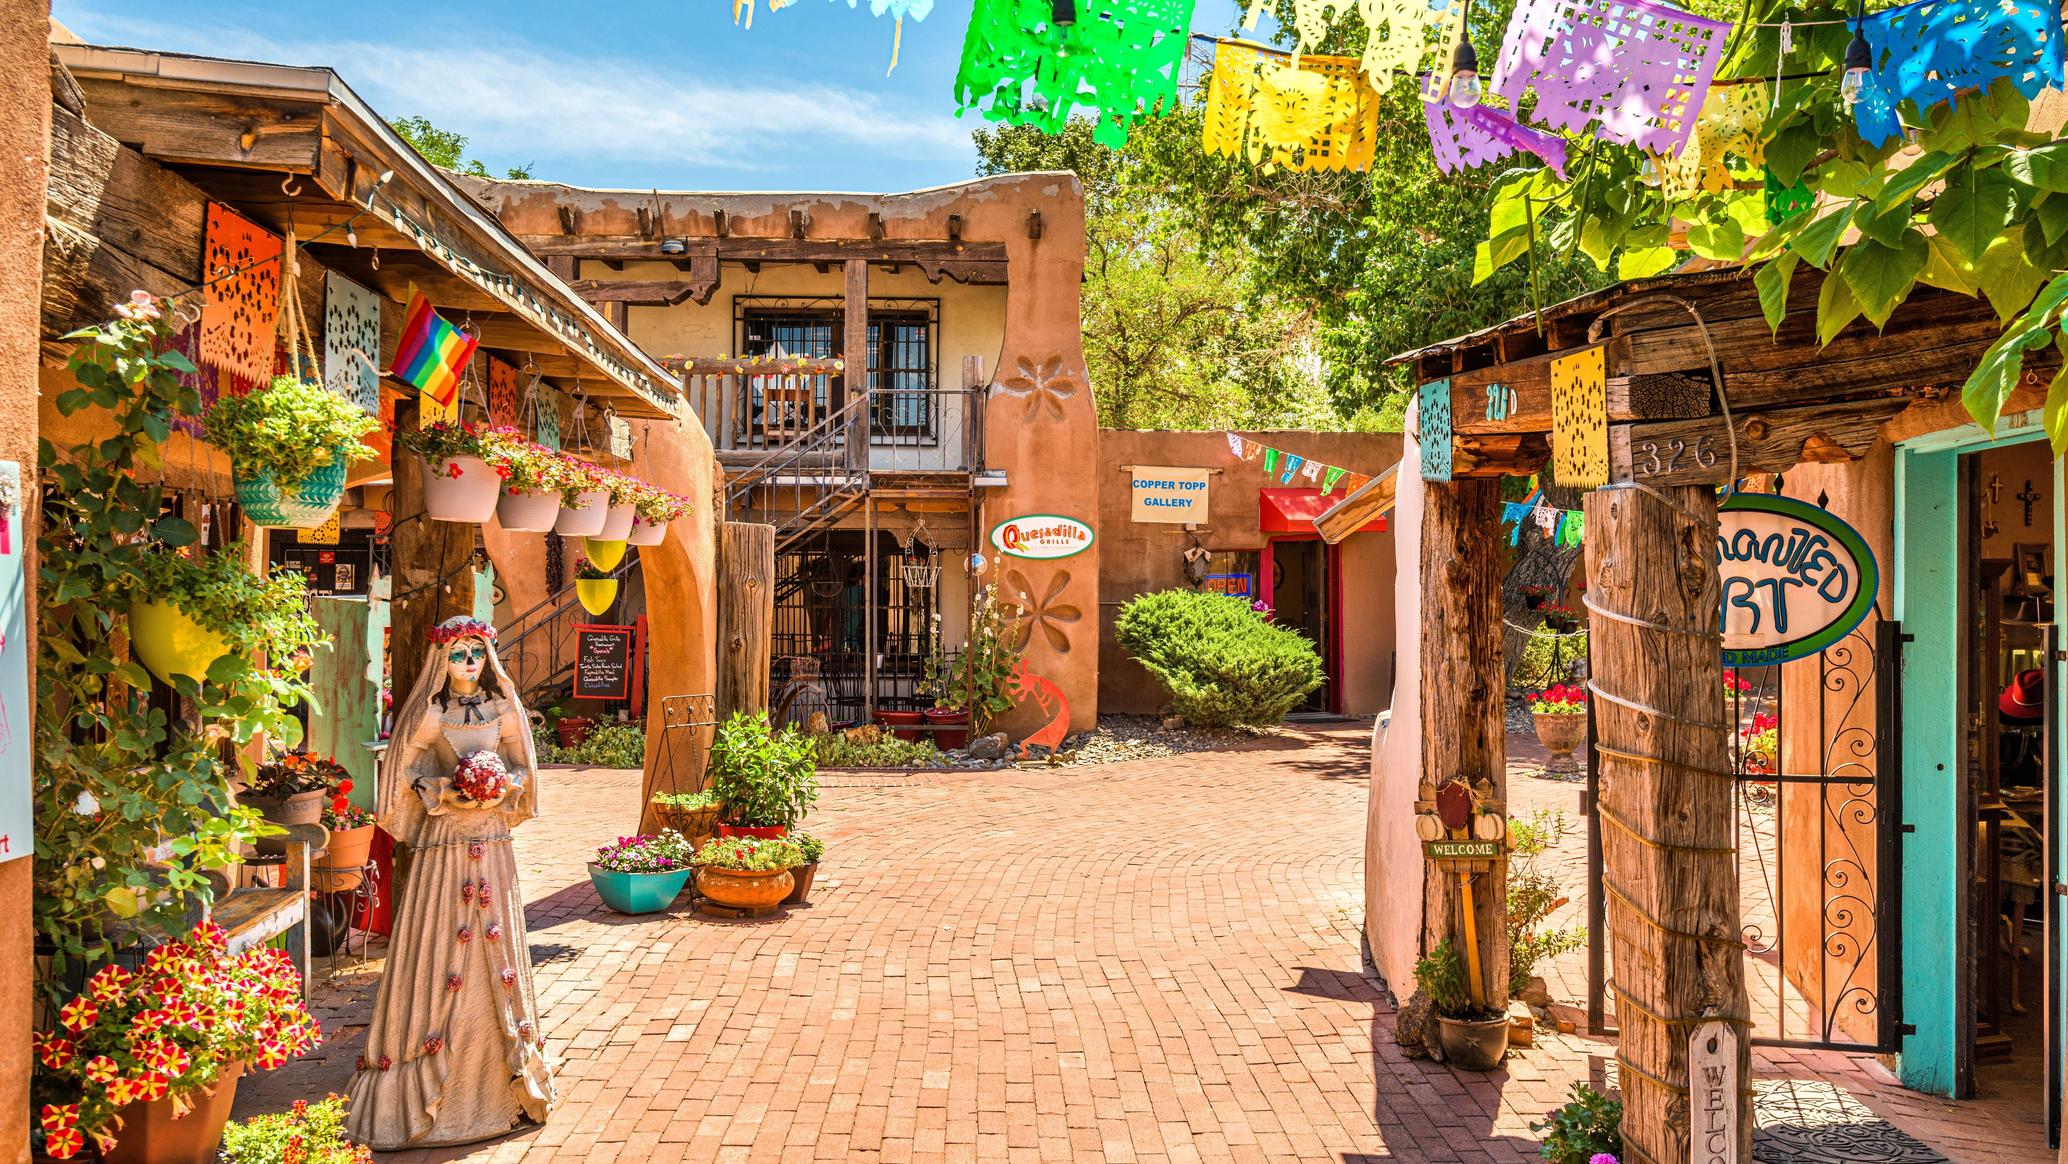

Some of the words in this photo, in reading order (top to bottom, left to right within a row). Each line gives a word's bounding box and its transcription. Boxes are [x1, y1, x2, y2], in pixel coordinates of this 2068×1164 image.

[1642, 435, 1717, 477] 326
[1132, 479, 1175, 490] COPPER
[1178, 481, 1206, 491] TOPP
[1144, 497, 1193, 508] GALLERY
[1003, 524, 1086, 553] Quesadilla
[1207, 577, 1249, 594] OPEN
[1719, 576, 1804, 635] RT
[1742, 646, 1789, 664] MADE
[1433, 843, 1493, 855] WELCOME
